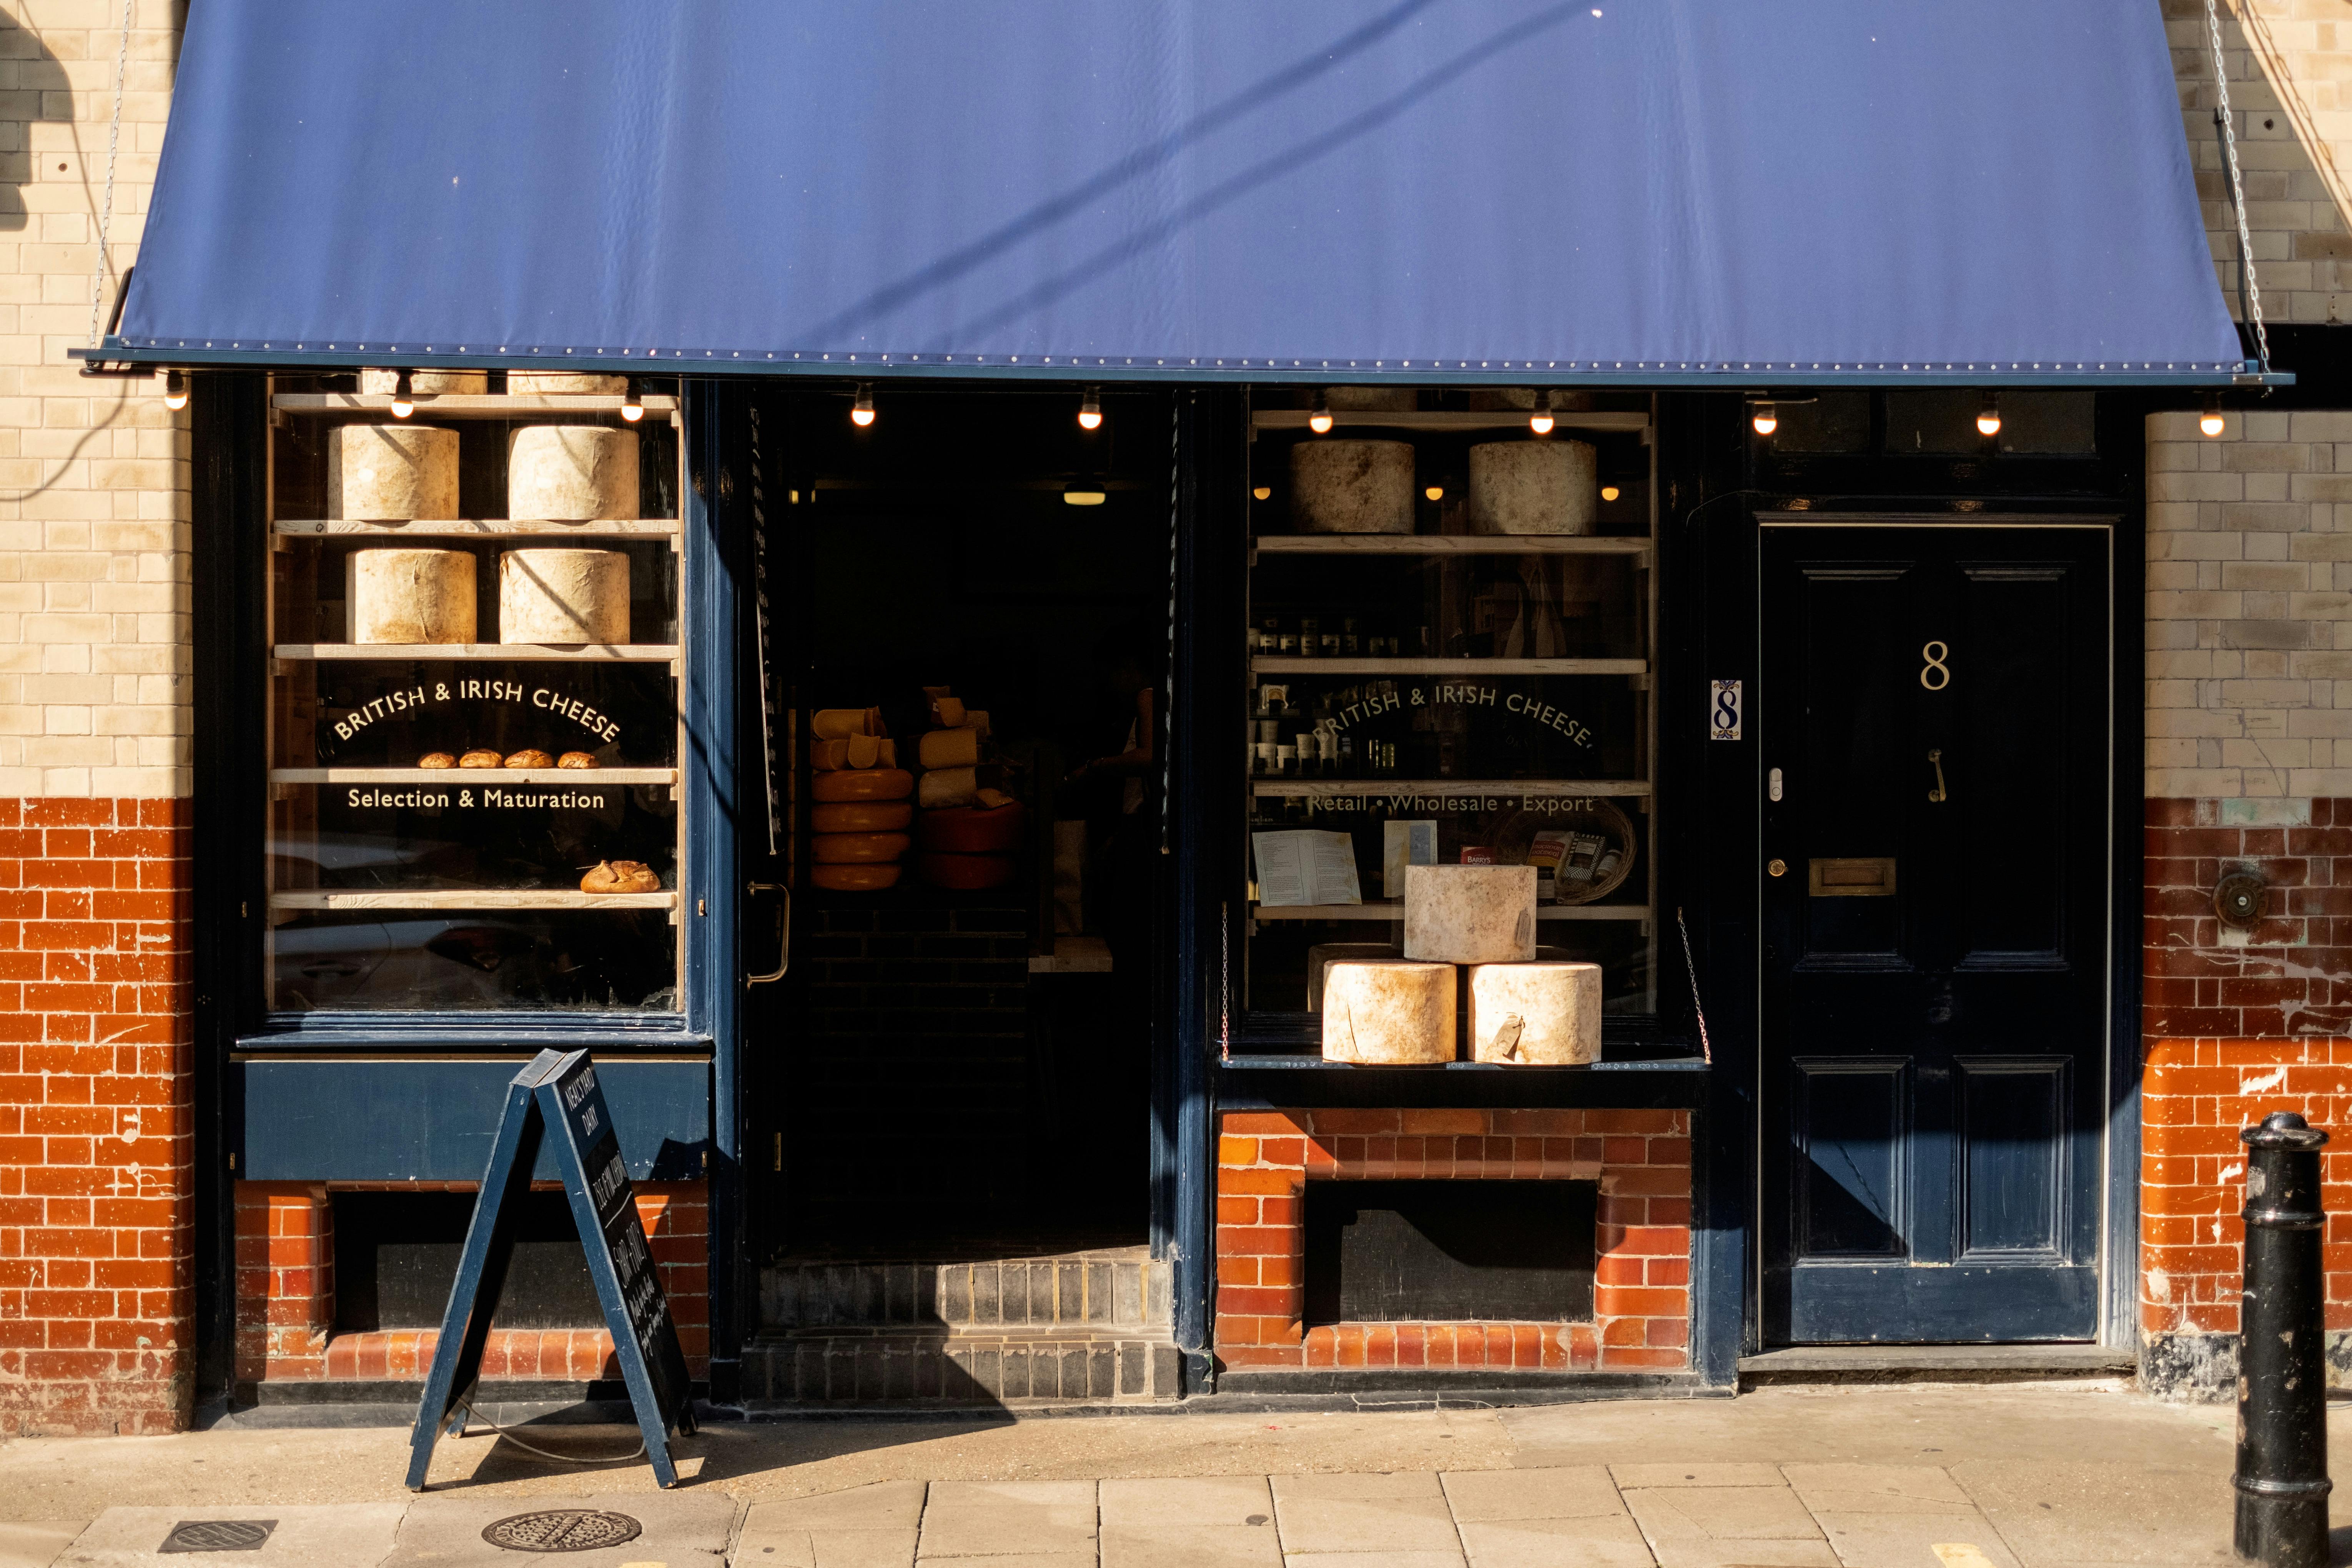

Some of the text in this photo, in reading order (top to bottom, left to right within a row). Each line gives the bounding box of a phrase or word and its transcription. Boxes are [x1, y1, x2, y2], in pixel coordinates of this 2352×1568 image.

[1921, 641, 1949, 690] 8
[334, 680, 620, 742] BRITISH & IRISH CHEESE
[1312, 685, 1591, 747] BRITISH & IRISH CHEESE
[1713, 690, 1738, 730] 8
[349, 789, 604, 808] Selection & Maturation
[1309, 793, 1594, 816] Retail Wholesale Export
[565, 1067, 595, 1111] NEAL'S YARD
[582, 1104, 599, 1136] DAIRY
[592, 1178, 607, 1211] ISLE
[601, 1173, 611, 1200] OF
